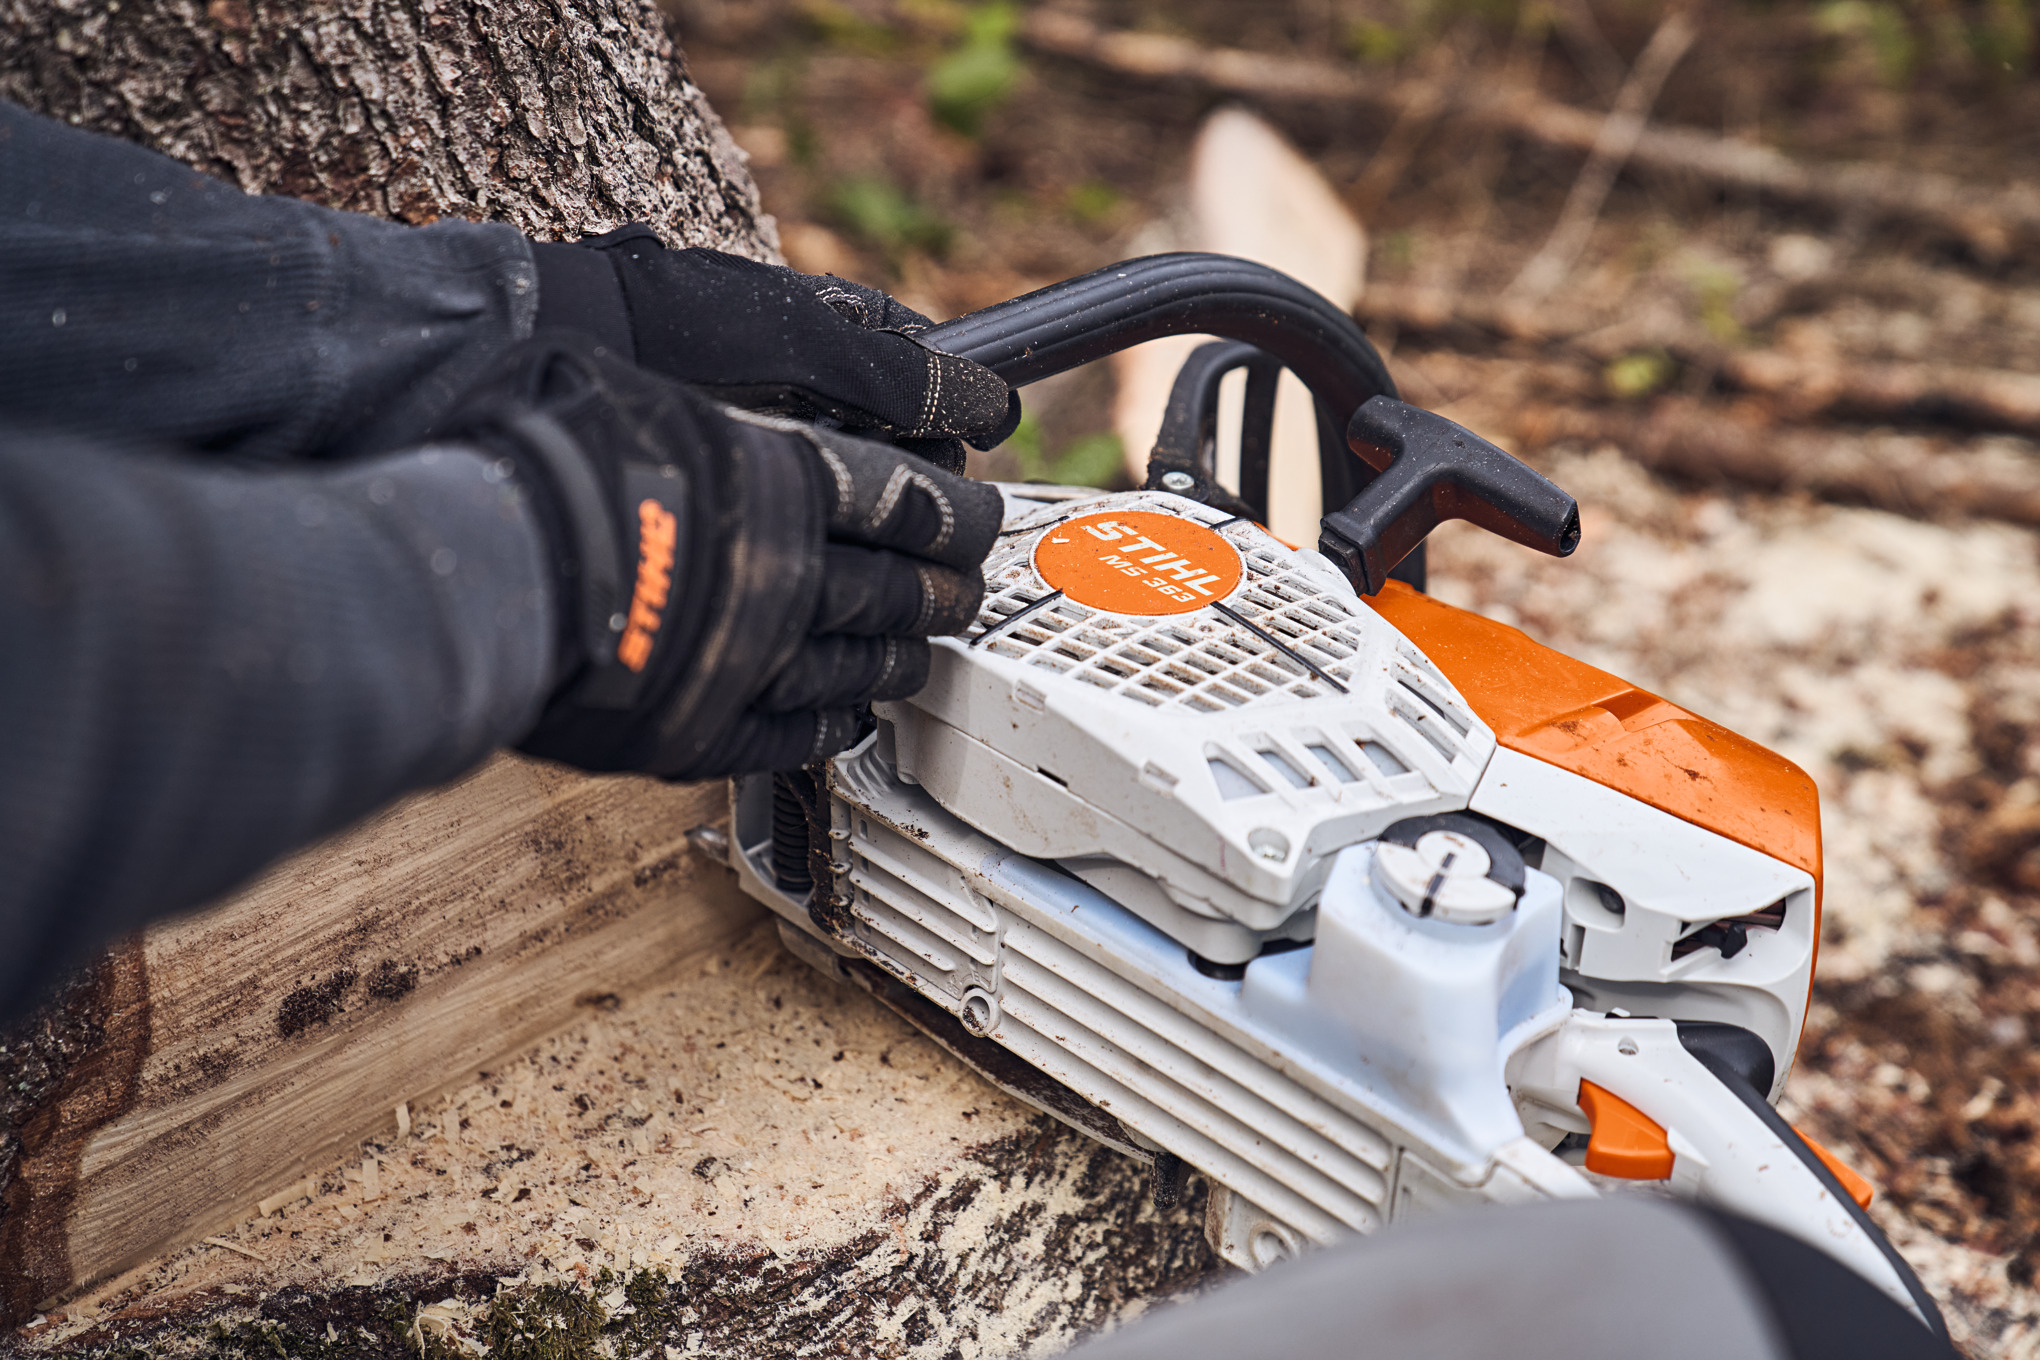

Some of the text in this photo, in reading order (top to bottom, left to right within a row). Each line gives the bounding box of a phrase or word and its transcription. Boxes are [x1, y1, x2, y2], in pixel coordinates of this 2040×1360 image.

[1080, 520, 1220, 596] STIHL
[1098, 554, 1197, 603] MS 363
